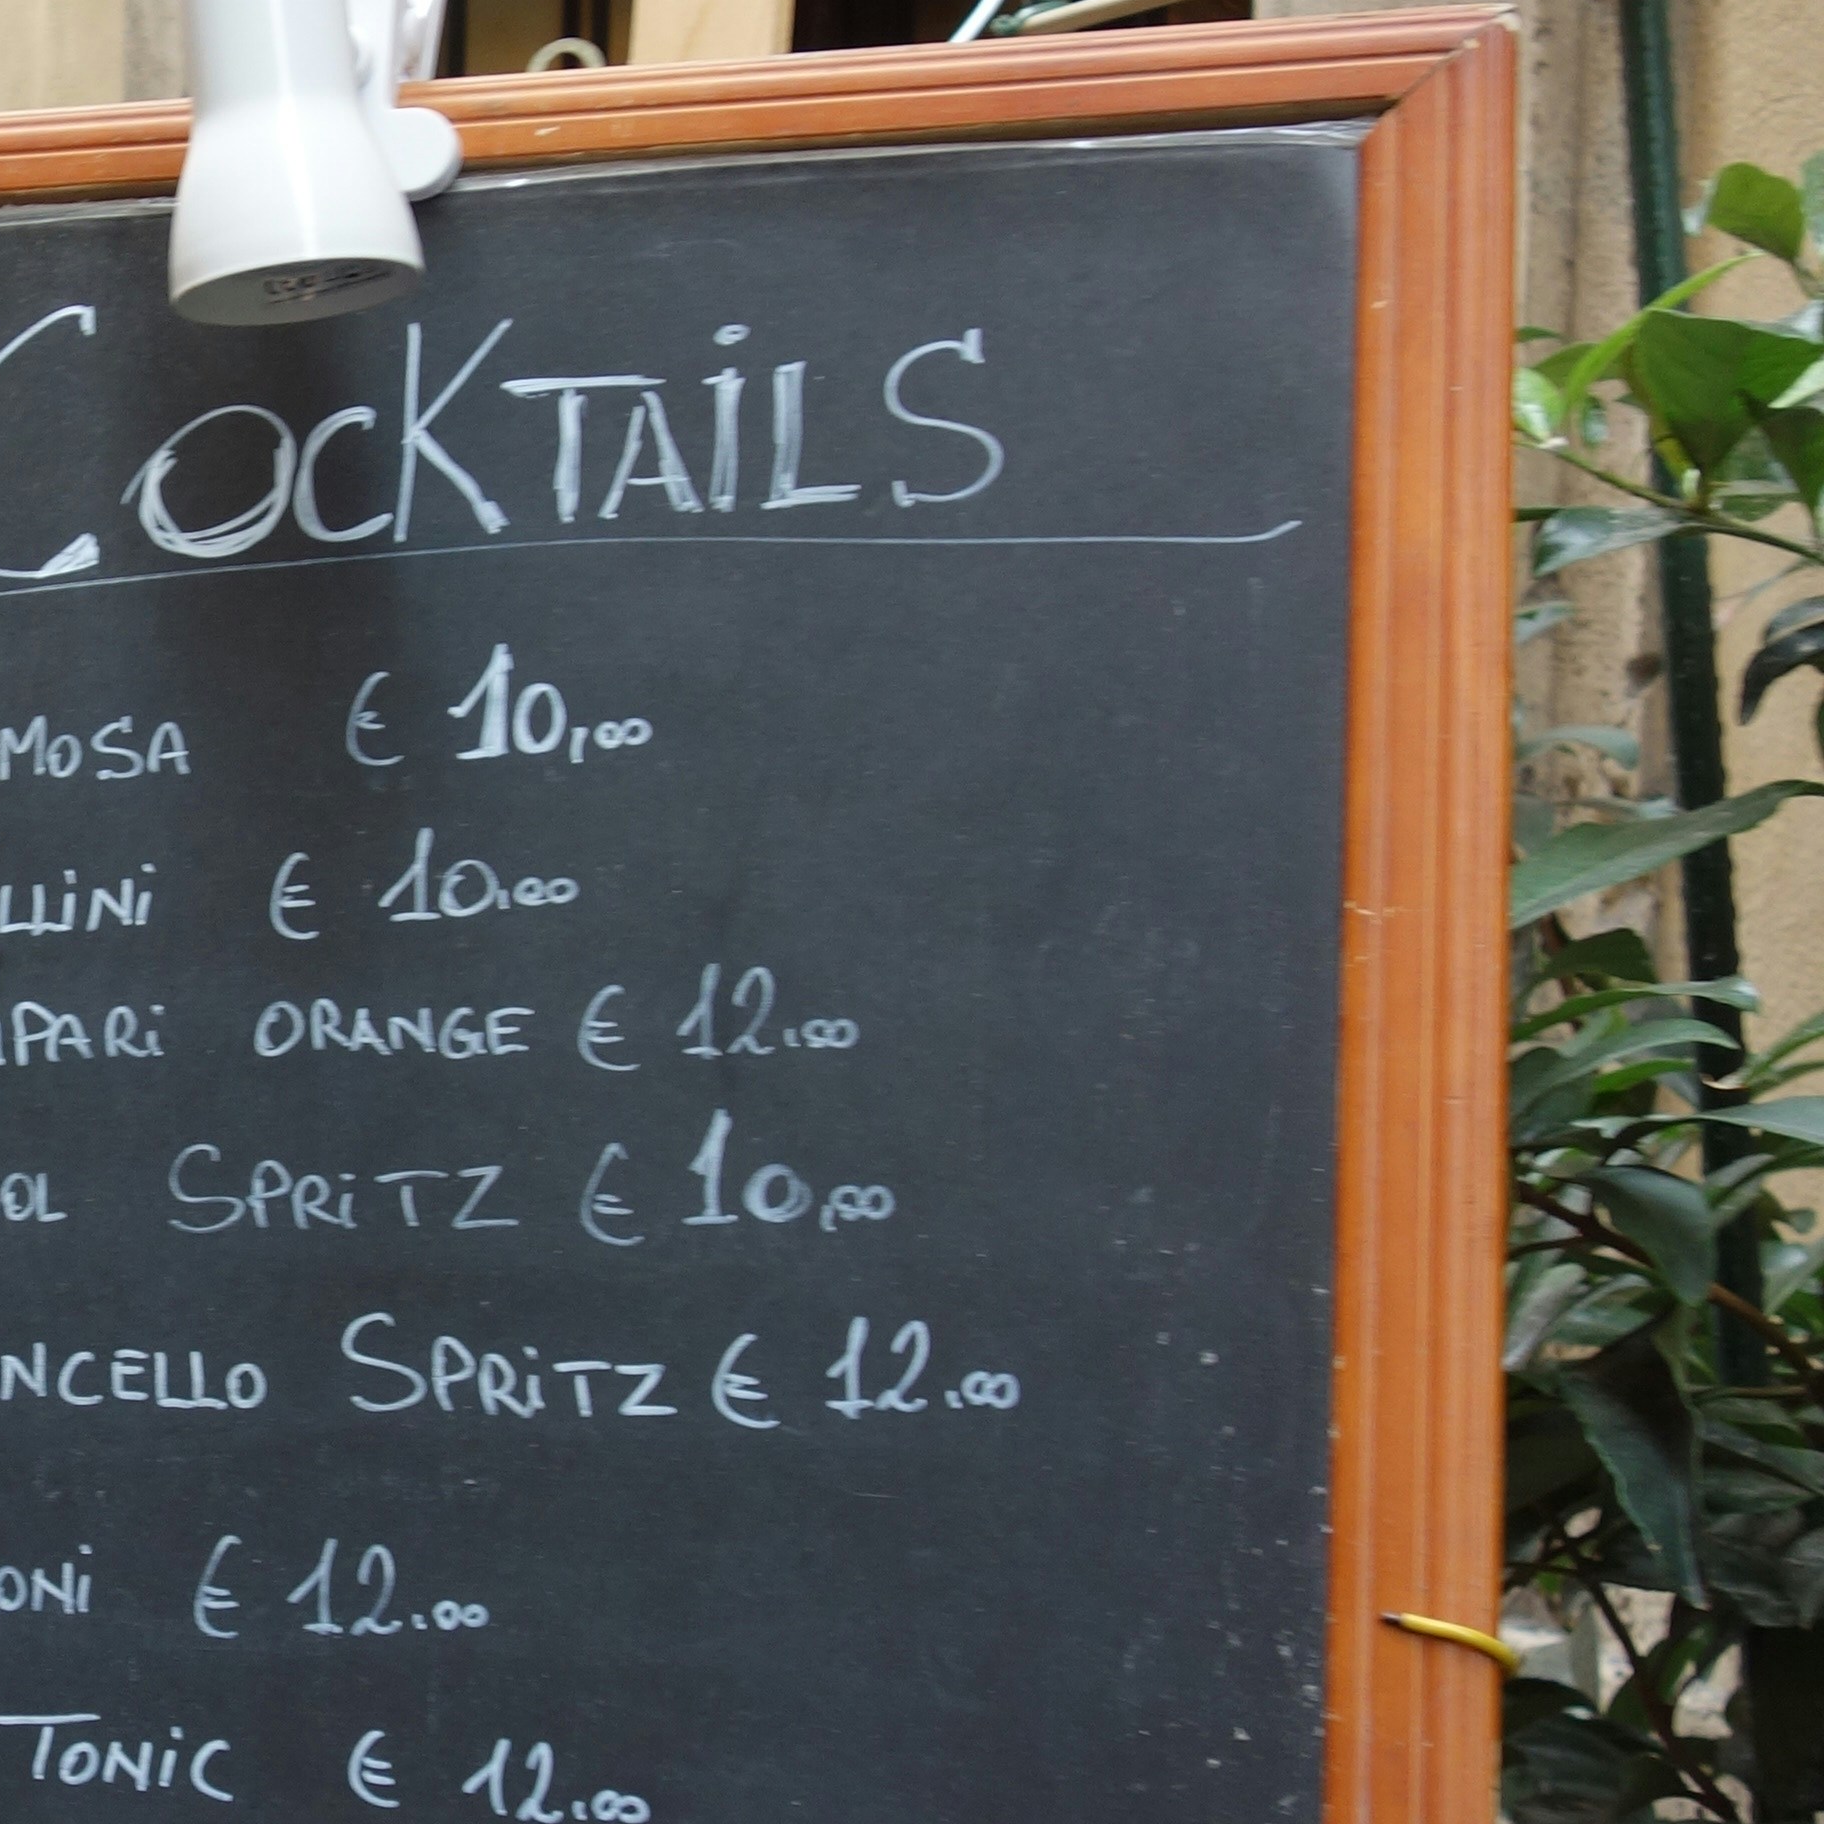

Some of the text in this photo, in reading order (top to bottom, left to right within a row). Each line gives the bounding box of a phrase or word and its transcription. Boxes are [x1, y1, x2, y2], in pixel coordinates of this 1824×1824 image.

[347, 671, 403, 766] €
[270, 852, 319, 940] €
[578, 985, 638, 1071] €
[581, 1143, 643, 1246] €
[711, 1333, 780, 1429] €
[194, 1535, 241, 1639] €
[347, 1729, 400, 1808] €
